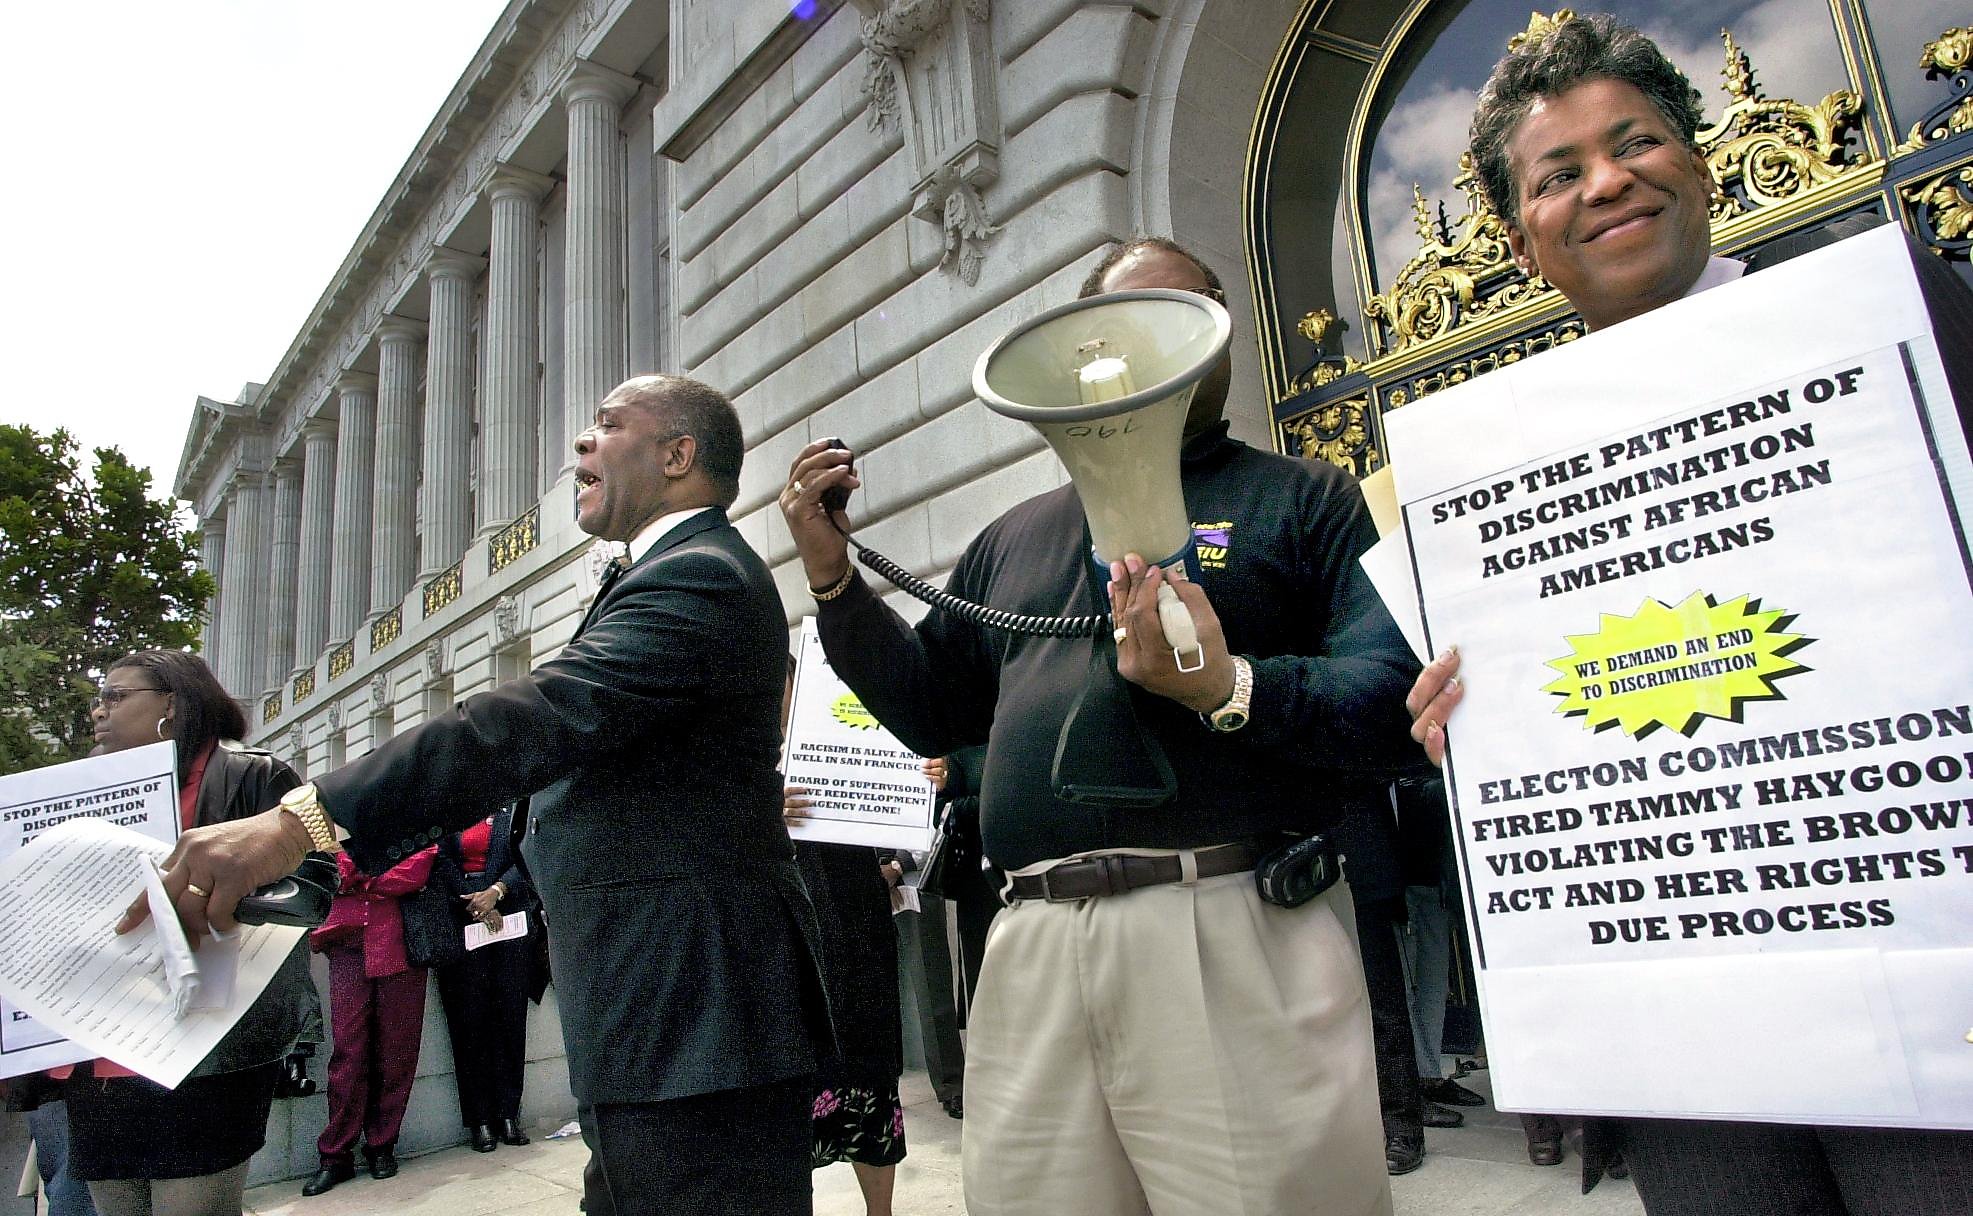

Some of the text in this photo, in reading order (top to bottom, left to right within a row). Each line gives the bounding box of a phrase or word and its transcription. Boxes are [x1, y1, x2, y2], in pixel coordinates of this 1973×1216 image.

[1432, 366, 1864, 524] STOP THE PATTERN OF
[1479, 423, 1815, 544] DISCRIMINATION
[1481, 459, 1833, 579] AGAINST AFRICAN
[1539, 517, 1775, 599] AMERICANS
[1575, 628, 1754, 679] WE DEMAND AN END
[1581, 652, 1758, 700] TO DISCRIMINATION
[792, 753, 921, 771] WELL IN SAN FRANCISC
[800, 743, 848, 754] RACISIM
[851, 746, 862, 755] IS
[863, 748, 898, 758] ALIVE
[1479, 705, 1973, 805] ELECTON COMMISSION
[3, 781, 162, 822] STOP THE PATTERN OF
[789, 775, 927, 795] BOARD OF SUPERVISORS
[824, 788, 928, 806] REDEVELOPMENT
[858, 804, 902, 815] ALONE!
[1472, 807, 1582, 842] FIRED
[1589, 783, 1743, 826] TAMMY
[1486, 832, 1694, 877] VIOLATING
[1701, 819, 1795, 854] THE
[1487, 845, 1973, 914] ACT AND HER RIGHTS T
[1588, 898, 1895, 946] DUE PROCESS
